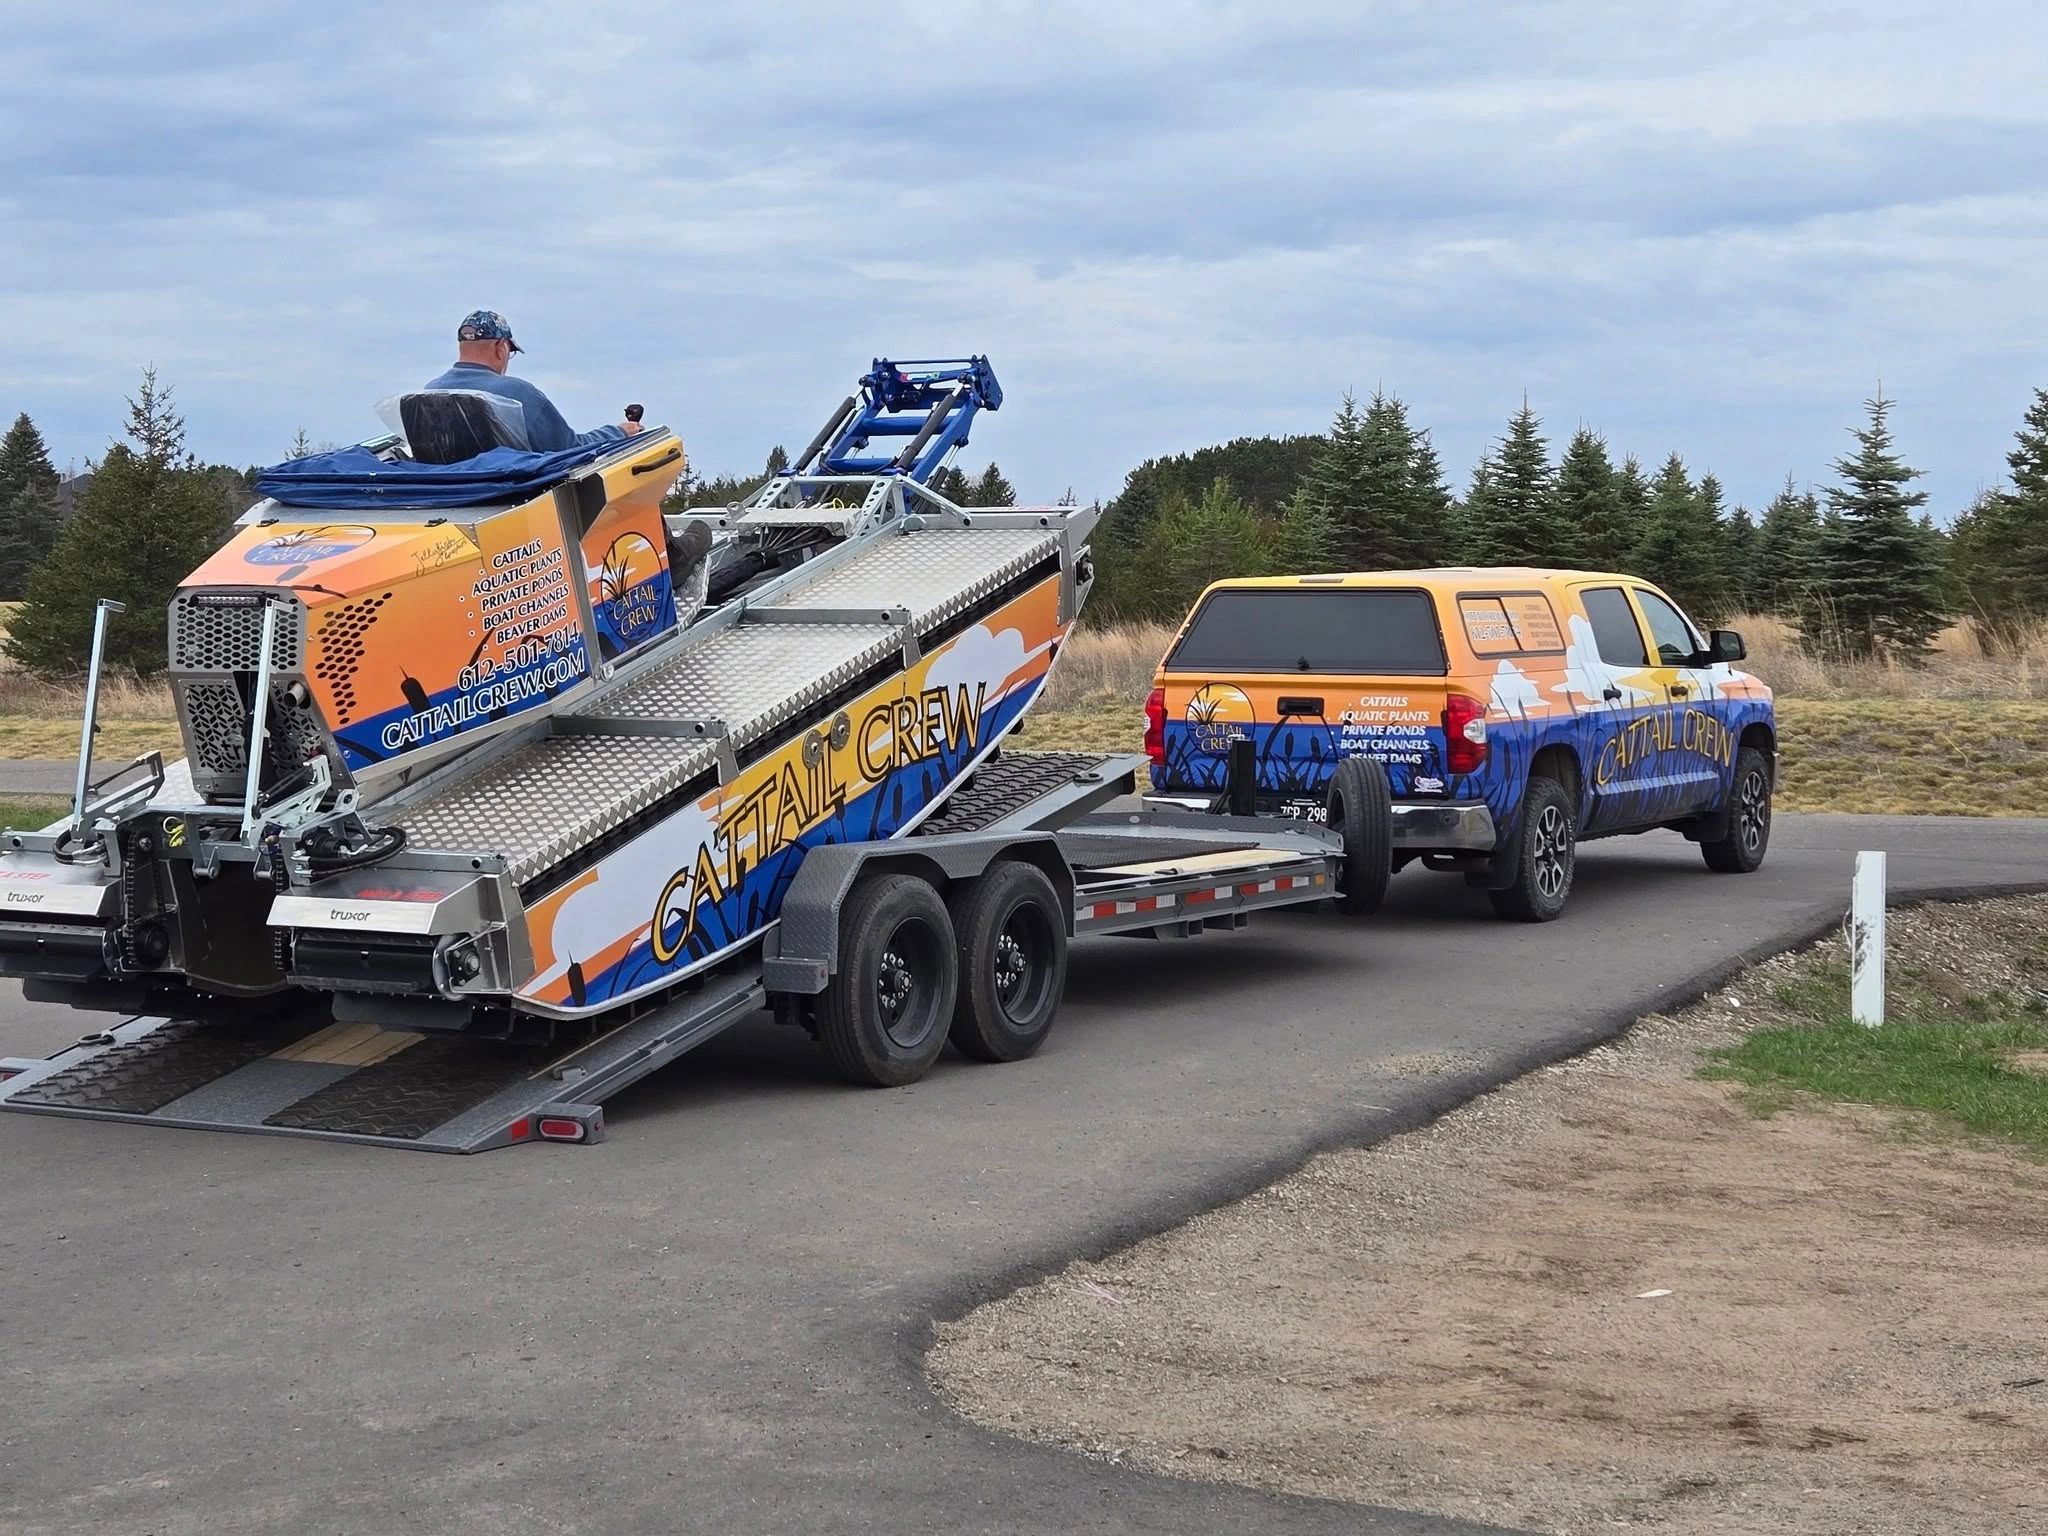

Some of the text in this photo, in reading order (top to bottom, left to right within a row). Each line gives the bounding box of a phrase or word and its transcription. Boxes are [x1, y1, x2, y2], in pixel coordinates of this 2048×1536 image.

[493, 539, 542, 568] CATTAILS
[472, 548, 562, 597] AQUATIC PLANTS
[481, 567, 563, 612] PRIVATE PONDS
[613, 584, 658, 620] CATTAIL
[483, 583, 569, 630] BOAT CHANNELS
[621, 604, 655, 635] CREW
[496, 604, 567, 645] BEAVER DAMS
[458, 619, 580, 692] 612-501-7814
[381, 647, 586, 749] CATTAILCREW.COM
[1360, 696, 1408, 707] CATTAILS
[1338, 711, 1430, 722] AQUATIC PLANTS
[1342, 725, 1426, 736] PRIVATE PONDS
[1201, 738, 1232, 751] CRE
[1340, 739, 1430, 750] BOAT CHANNELS
[1390, 753, 1422, 764] DAMS
[1597, 709, 1734, 785] CATTAIL CREW
[651, 682, 986, 965] CATTAIL CREW
[1307, 807, 1328, 822] 298
[7, 891, 44, 903] truxor
[330, 908, 371, 921] truxor
